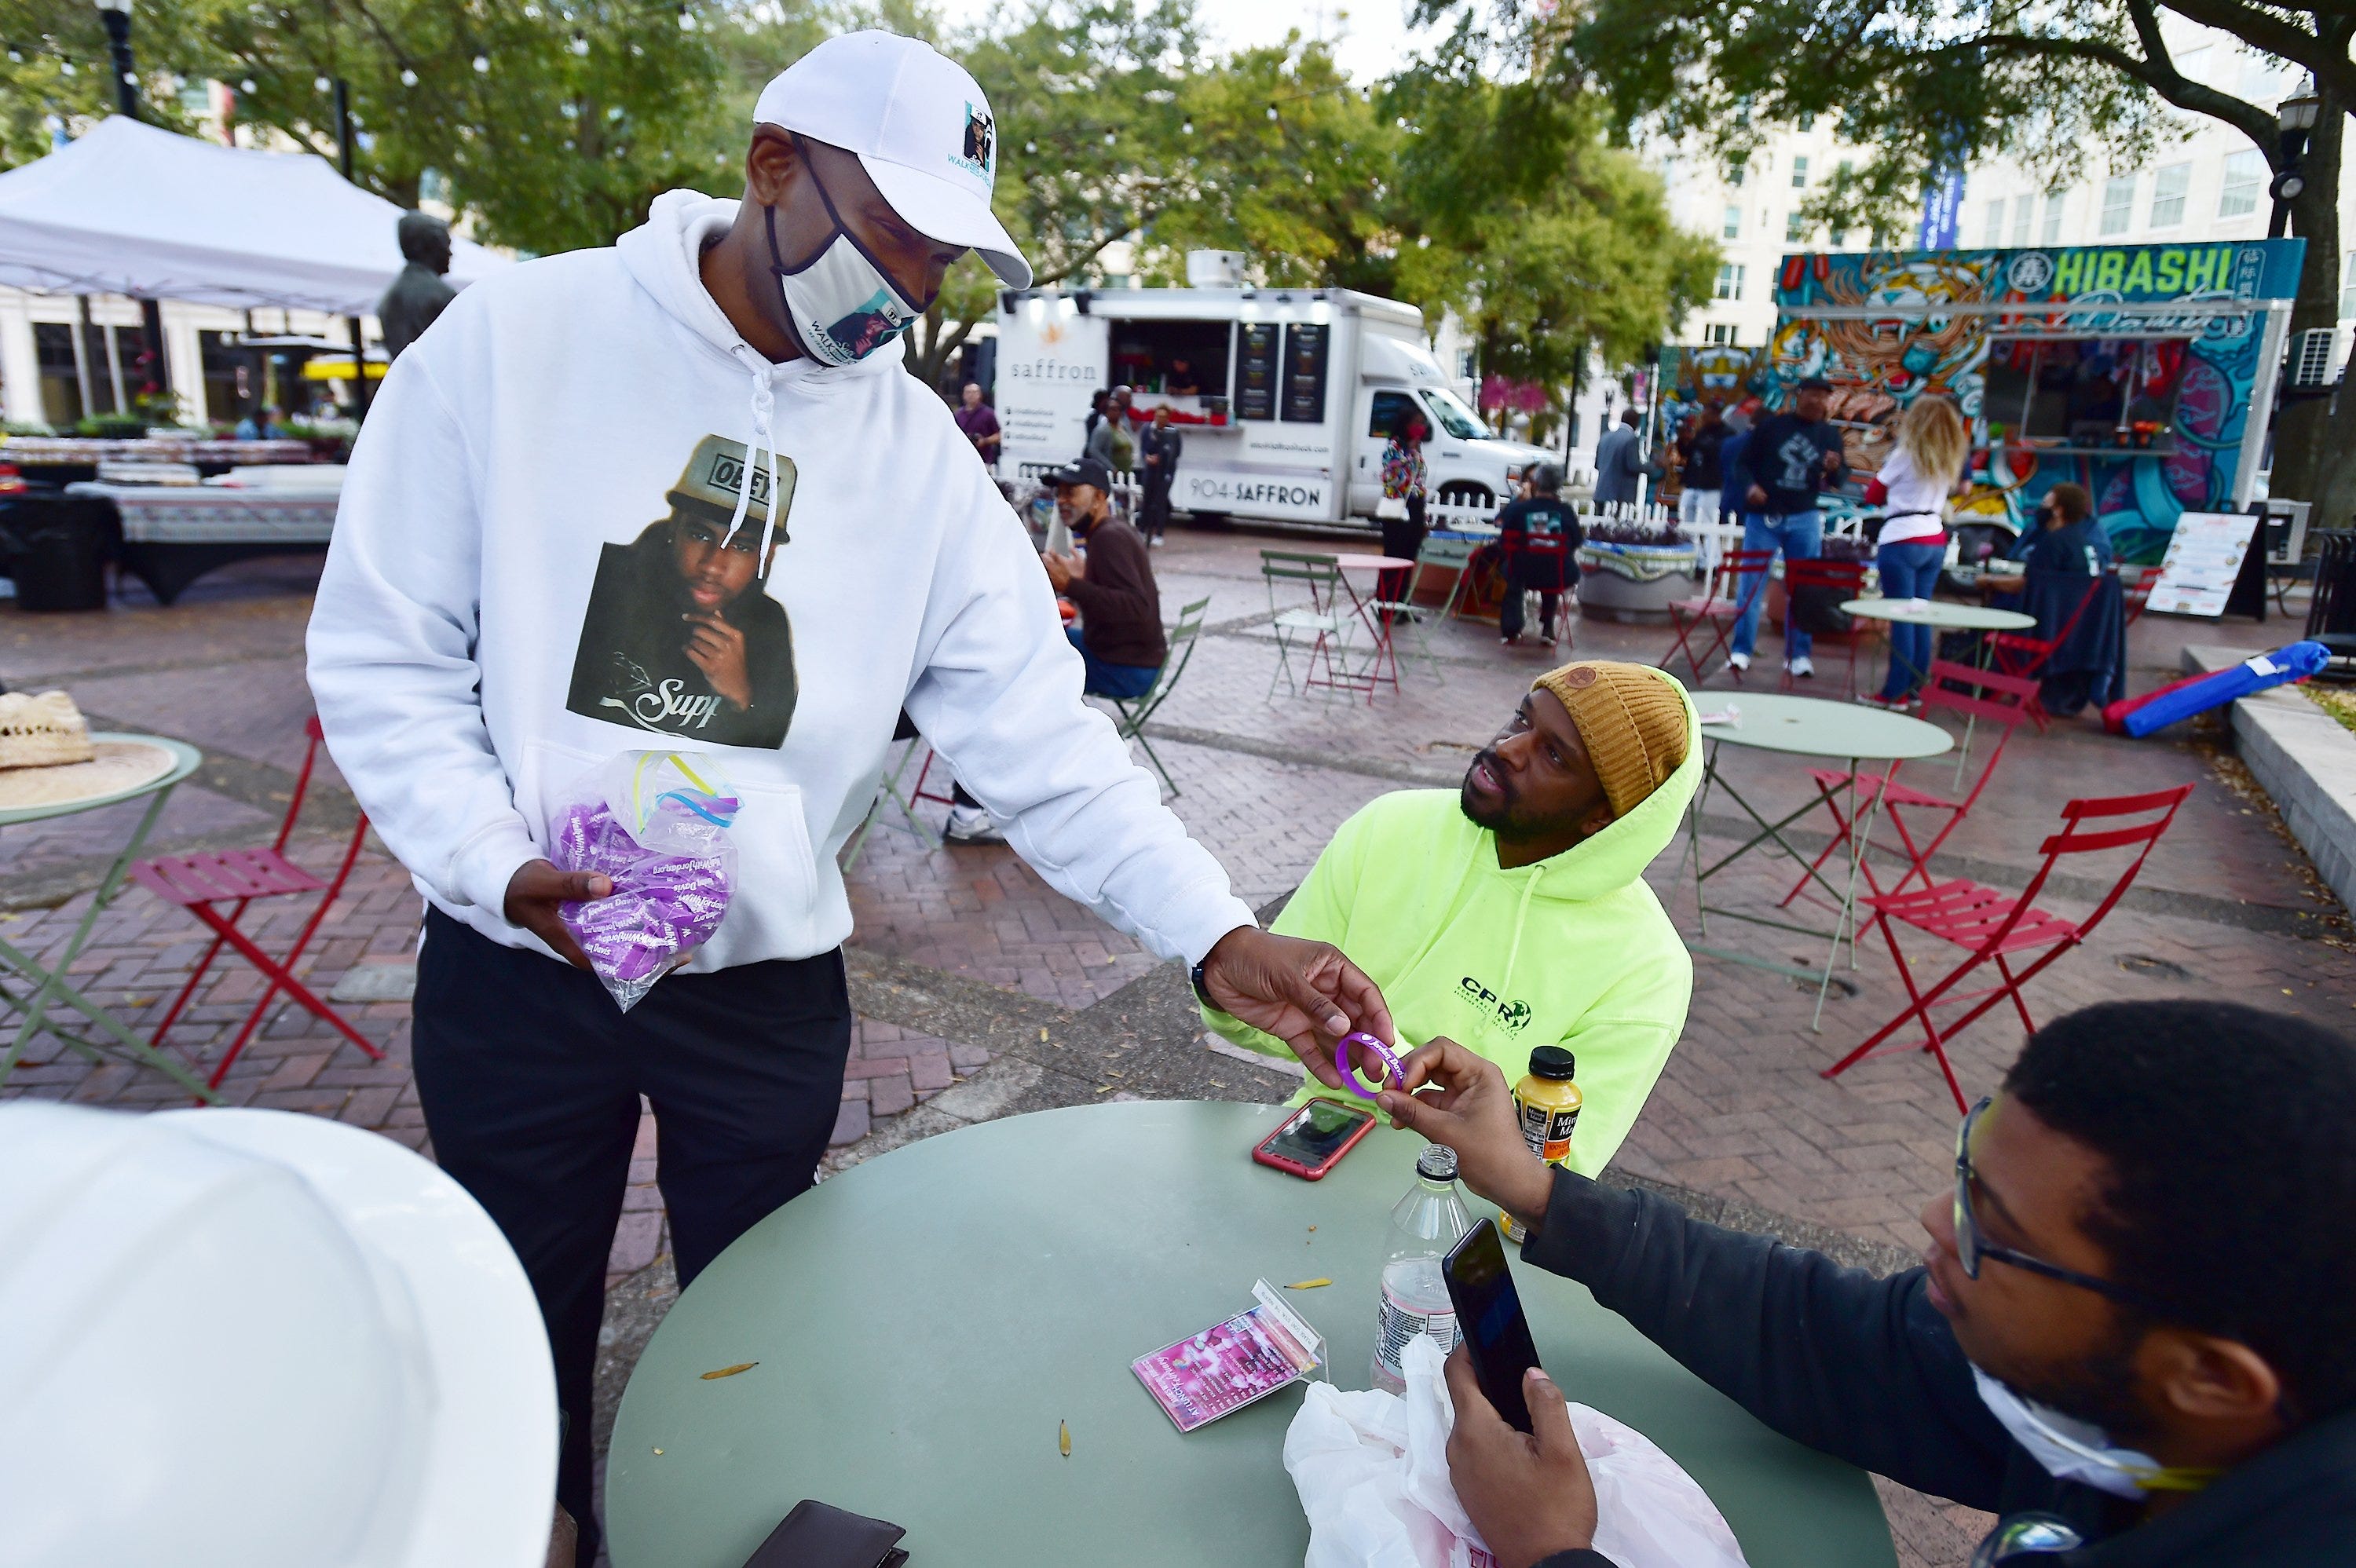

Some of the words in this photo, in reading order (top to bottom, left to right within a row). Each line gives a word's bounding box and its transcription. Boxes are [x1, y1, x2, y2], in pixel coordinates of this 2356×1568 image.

[948, 153, 971, 171] WALK
[2053, 248, 2232, 294] HIBASHI
[811, 320, 835, 351] WALK
[1011, 358, 1097, 380] saffron
[672, 881, 697, 893] Davis
[587, 902, 613, 919] Jordan
[594, 943, 611, 956] Davis
[1462, 977, 1514, 1023] CPR
[1368, 1040, 1392, 1061] Jordan
[1389, 1058, 1405, 1080] Davis
[1557, 1117, 1577, 1127] Min
[1559, 1126, 1574, 1136] Ma
[1157, 1356, 1184, 1388] February
[1173, 1386, 1194, 1407] LUNCH
[1188, 1406, 1200, 1416] AT
